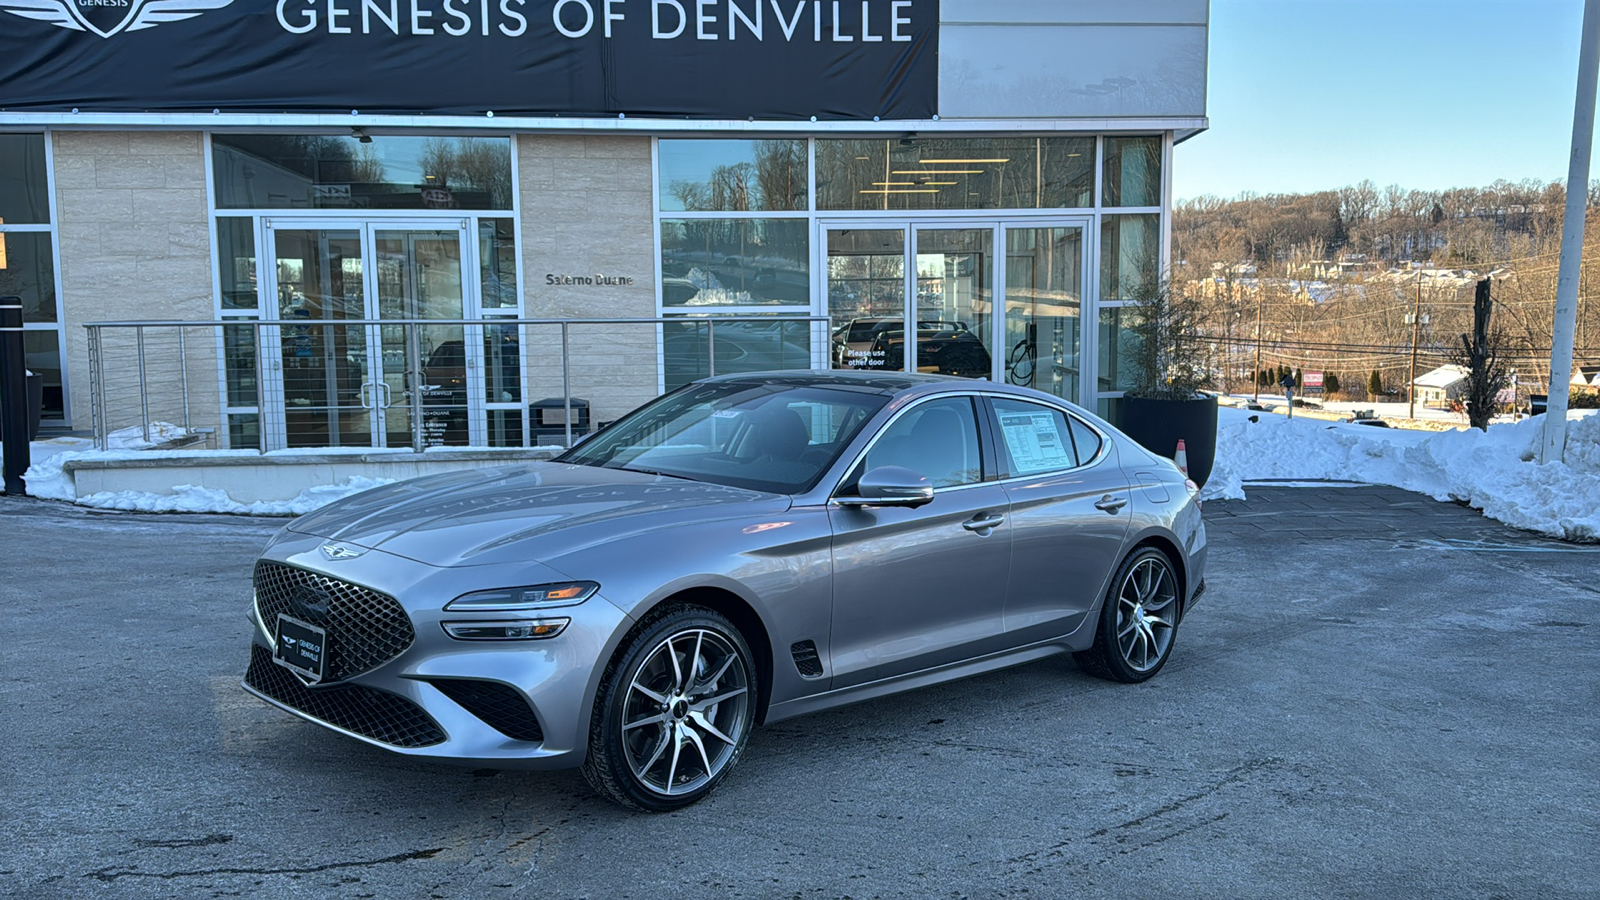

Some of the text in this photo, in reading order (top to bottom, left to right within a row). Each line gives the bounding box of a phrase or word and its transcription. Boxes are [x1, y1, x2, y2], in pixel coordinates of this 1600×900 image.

[275, 0, 913, 42] GENESIS OF DENVILLE
[546, 274, 634, 286] Salerno Duane
